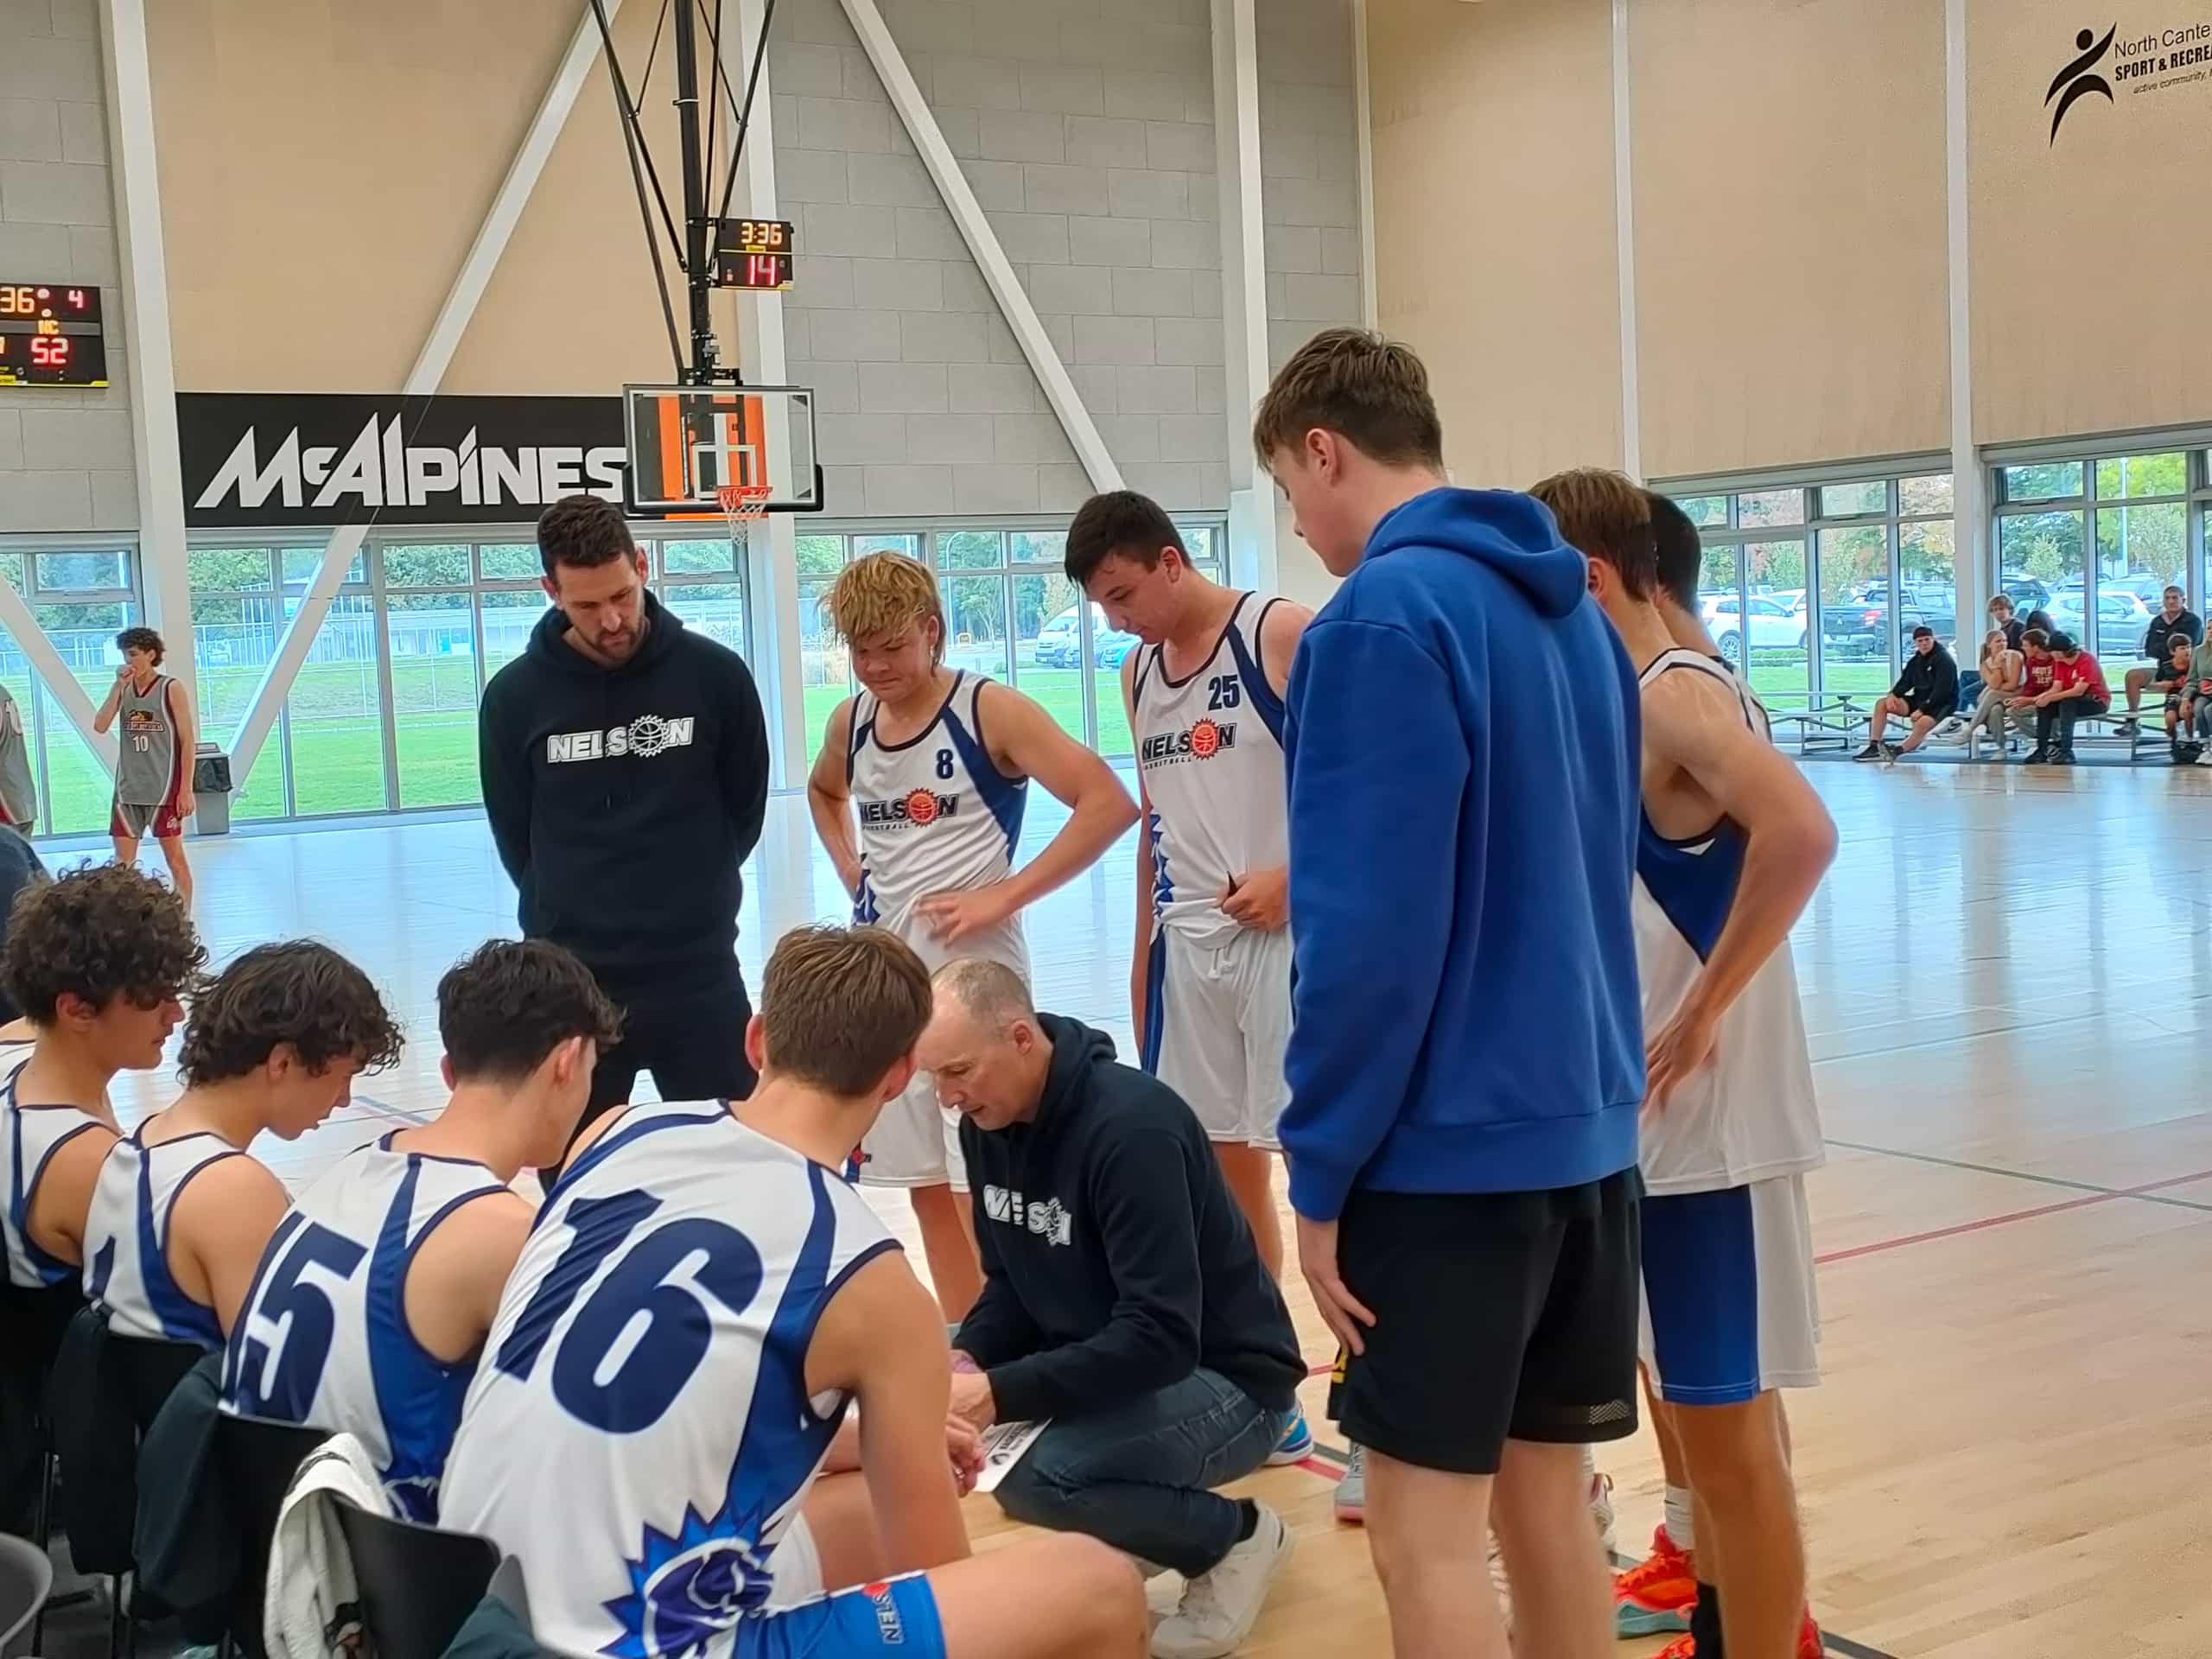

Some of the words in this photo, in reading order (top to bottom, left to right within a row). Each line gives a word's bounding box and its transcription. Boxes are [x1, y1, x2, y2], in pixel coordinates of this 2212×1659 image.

[2114, 35, 2158, 59] North
[2114, 58, 2156, 81] SPORT
[2158, 58, 2167, 71] &
[2170, 45, 2212, 69] RECRE
[741, 222, 783, 245] 3:36
[748, 255, 776, 286] 14
[68, 289, 84, 308] 4
[31, 337, 69, 364] 52
[1208, 673, 1241, 712] 25
[132, 735, 149, 753] 10
[548, 715, 695, 763] NELSON
[936, 748, 955, 779] 8
[493, 1188, 765, 1435] 16
